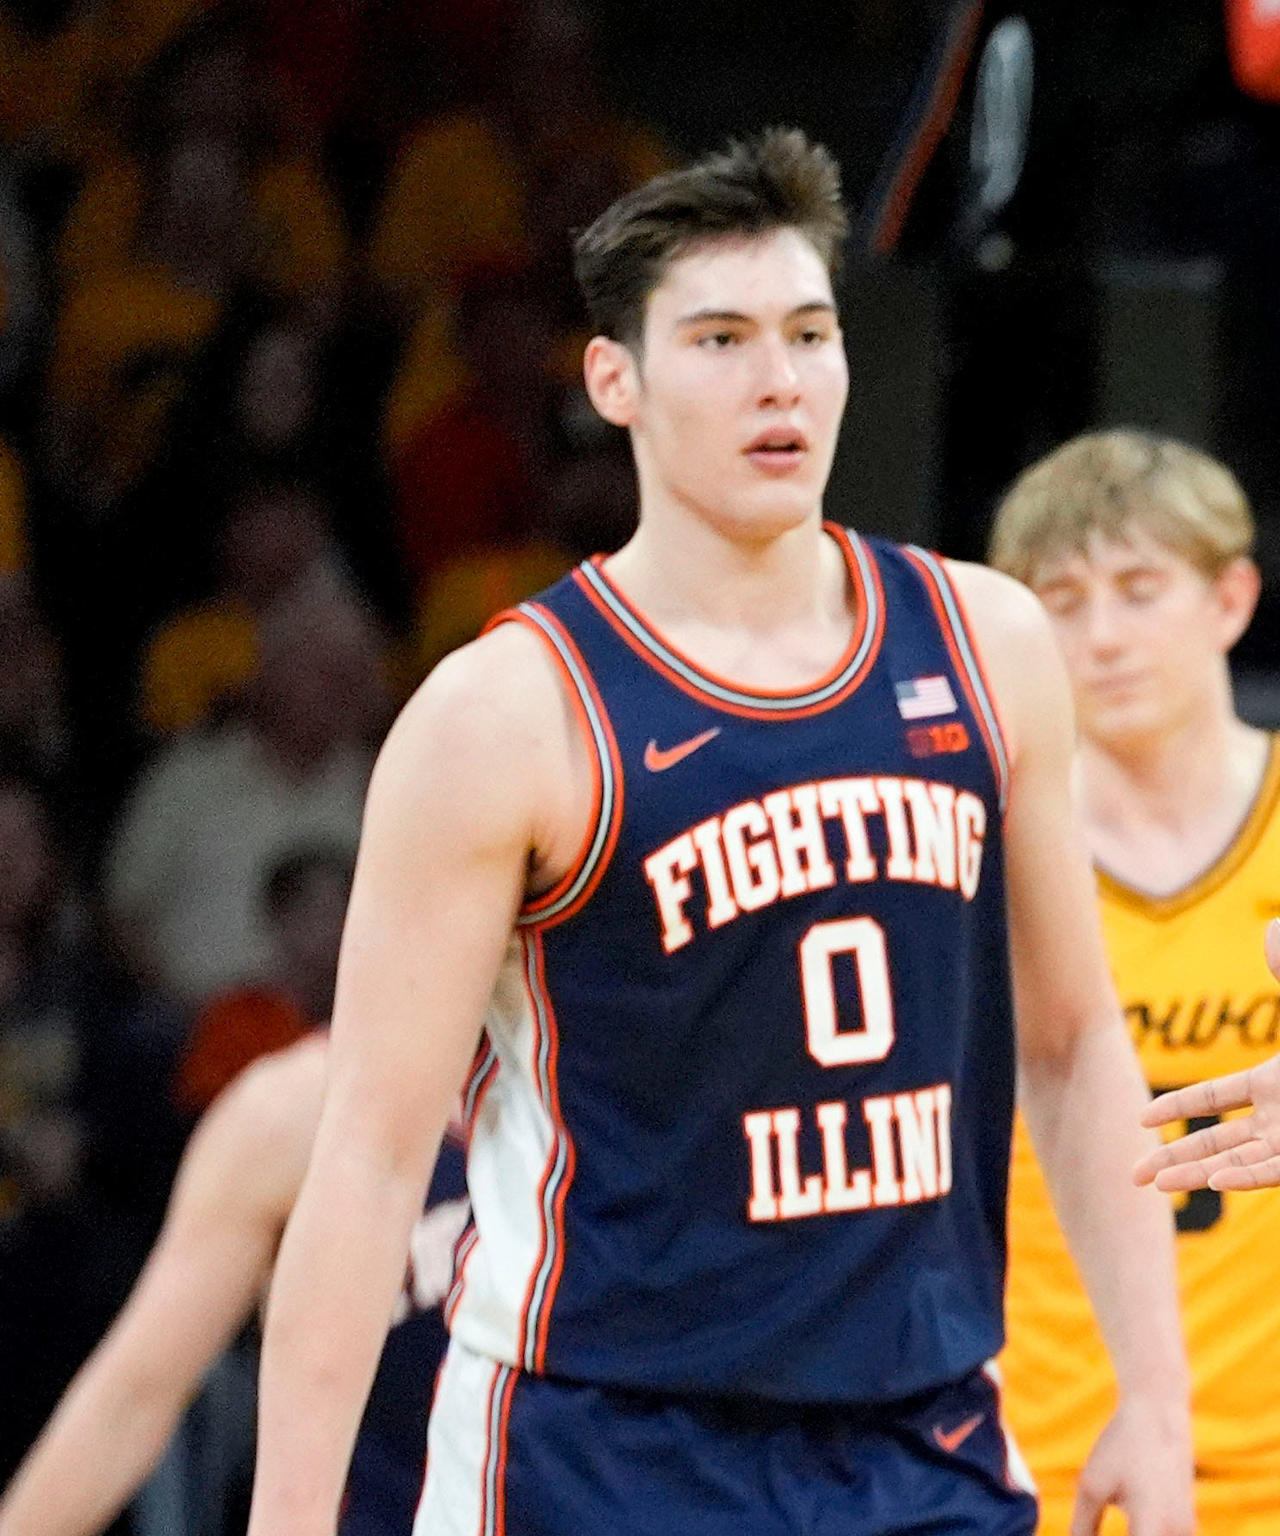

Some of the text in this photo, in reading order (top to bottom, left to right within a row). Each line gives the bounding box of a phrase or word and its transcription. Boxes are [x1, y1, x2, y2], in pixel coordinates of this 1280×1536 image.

[643, 775, 988, 956] FIGHTING
[798, 914, 896, 1068] 0
[743, 1082, 953, 1223] ILLINI
